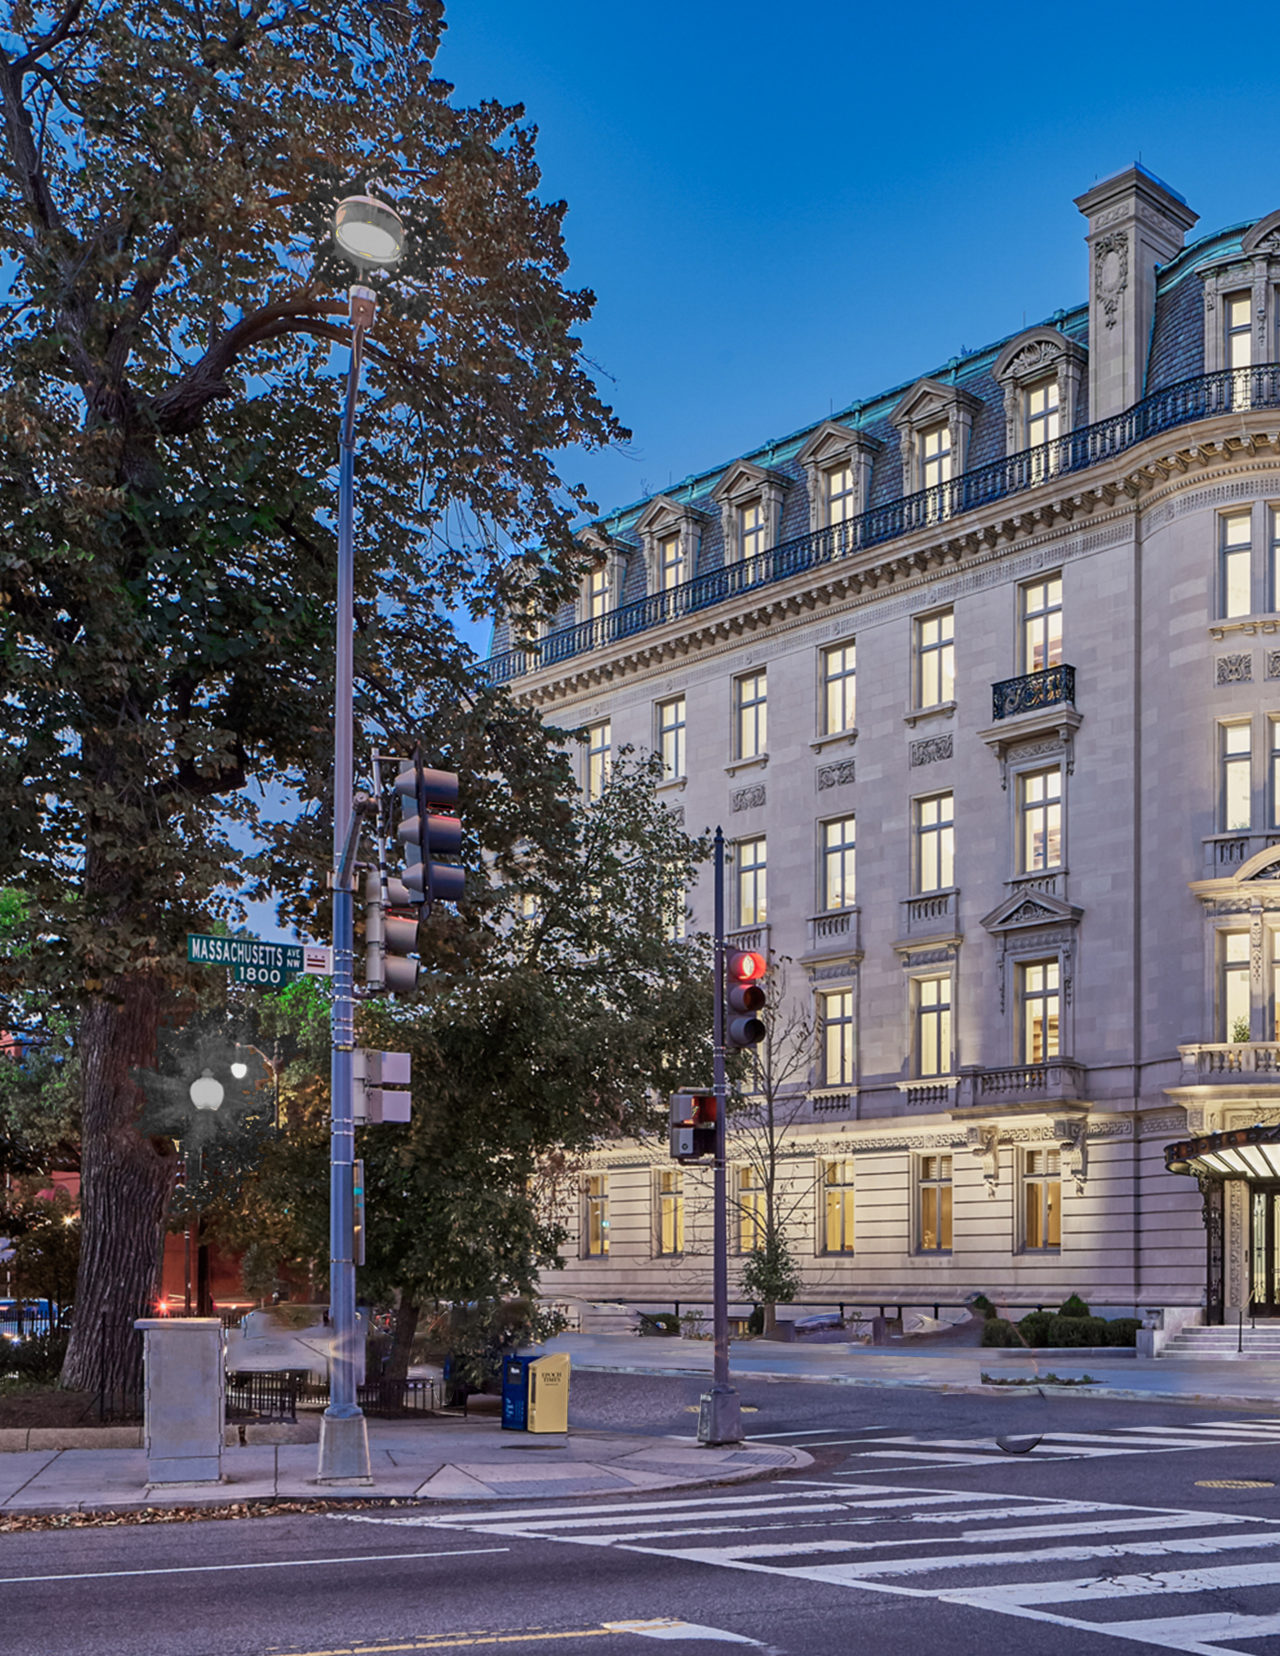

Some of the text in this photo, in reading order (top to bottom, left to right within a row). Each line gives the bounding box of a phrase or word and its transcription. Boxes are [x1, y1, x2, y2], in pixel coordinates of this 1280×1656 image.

[191, 937, 301, 967] MASSACHUSETTS AVE
[286, 959, 301, 968] NW
[239, 966, 281, 984] 1800
